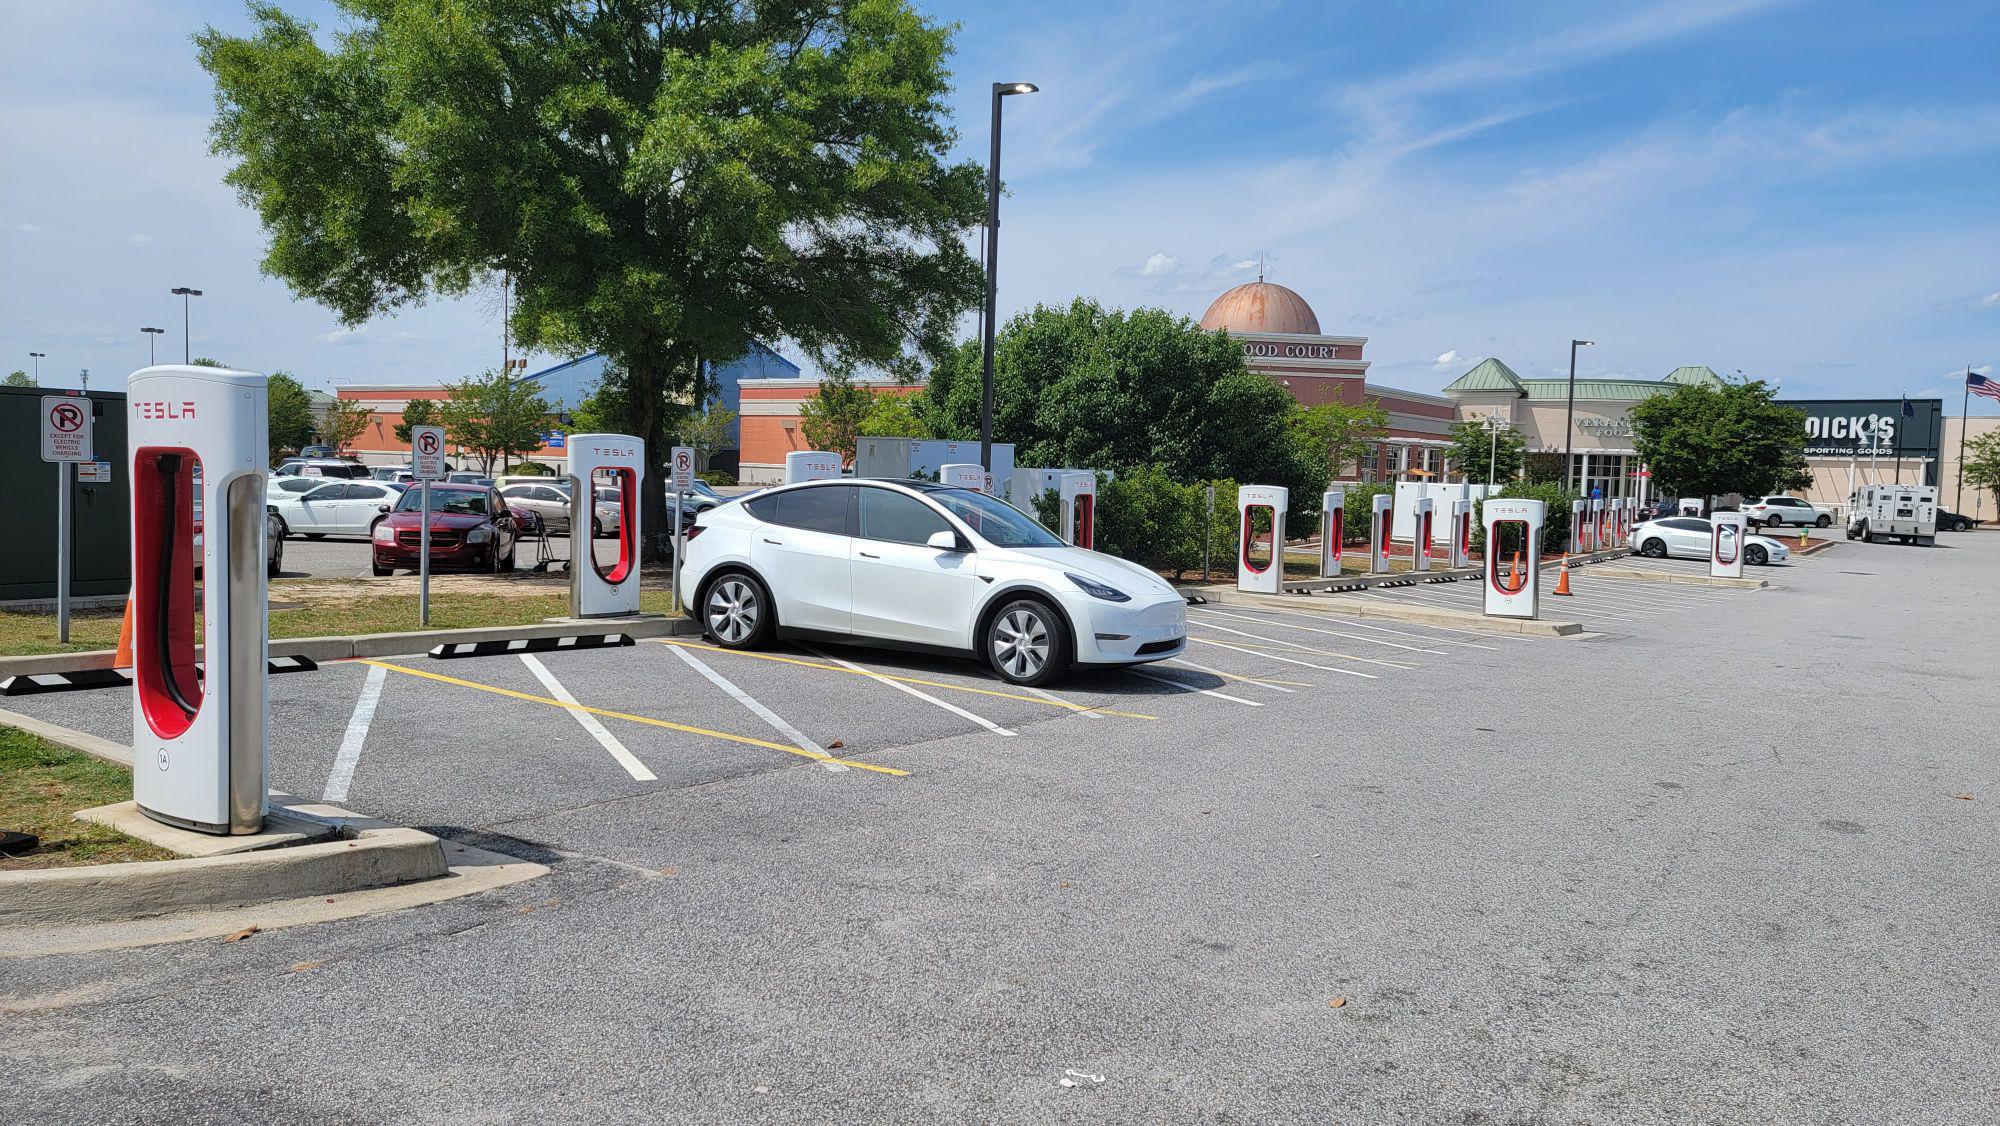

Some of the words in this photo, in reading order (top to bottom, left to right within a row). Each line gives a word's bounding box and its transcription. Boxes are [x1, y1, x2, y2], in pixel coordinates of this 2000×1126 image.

[1242, 344, 1278, 357] OOD
[1285, 345, 1339, 359] COURT
[134, 402, 195, 419] TESLA
[593, 448, 634, 456] TESLA
[806, 463, 836, 471] TESLA
[159, 754, 168, 765] 1A
